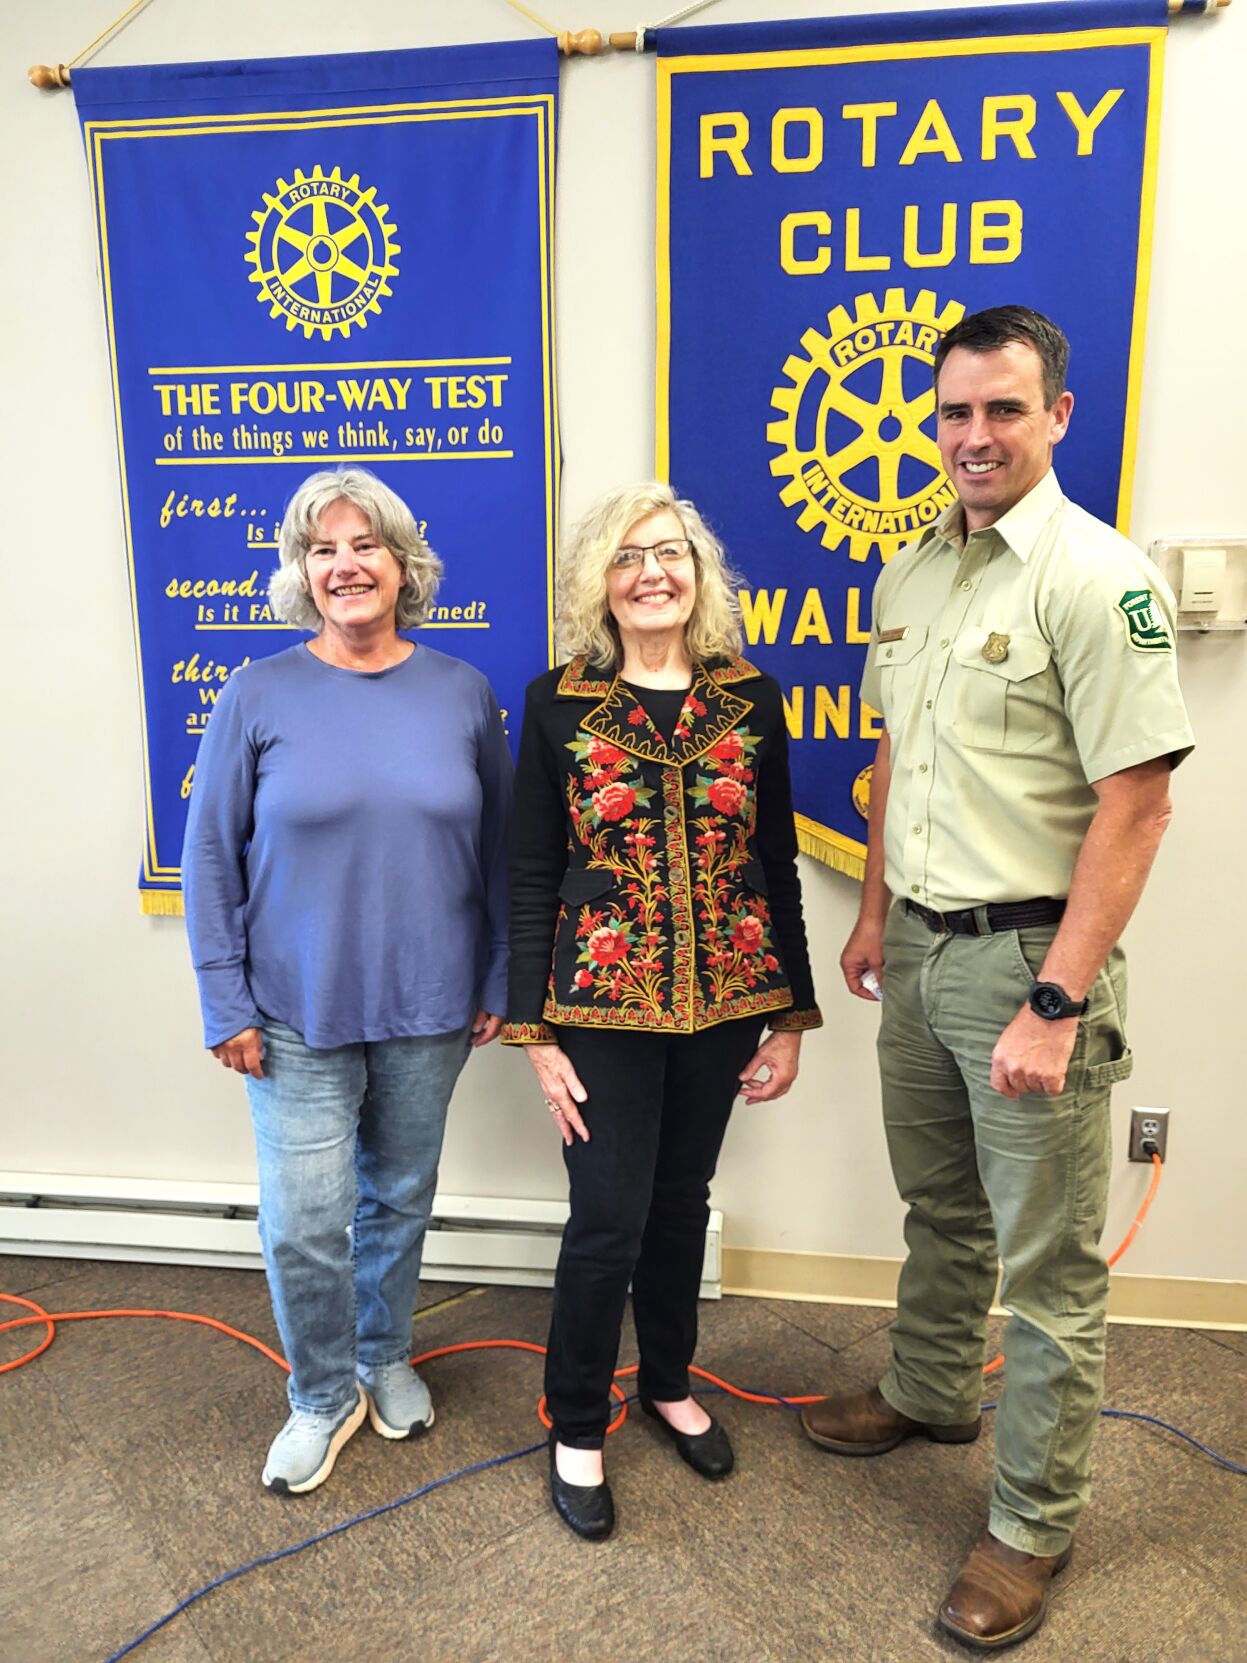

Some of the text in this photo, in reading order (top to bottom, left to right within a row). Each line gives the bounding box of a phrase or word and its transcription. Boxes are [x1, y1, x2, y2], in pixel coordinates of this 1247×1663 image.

[700, 89, 1125, 179] ROTARY
[288, 182, 350, 204] ROTARY
[780, 199, 1024, 276] CLUB
[269, 277, 379, 324] INTERNATIONAL
[833, 320, 947, 367] ROTAR
[153, 374, 509, 416] THE FOUR-WAY TEST
[163, 418, 504, 456] of the things we think, say, or do
[247, 523, 264, 541] Is
[197, 605, 214, 622] Is
[224, 604, 239, 622] it
